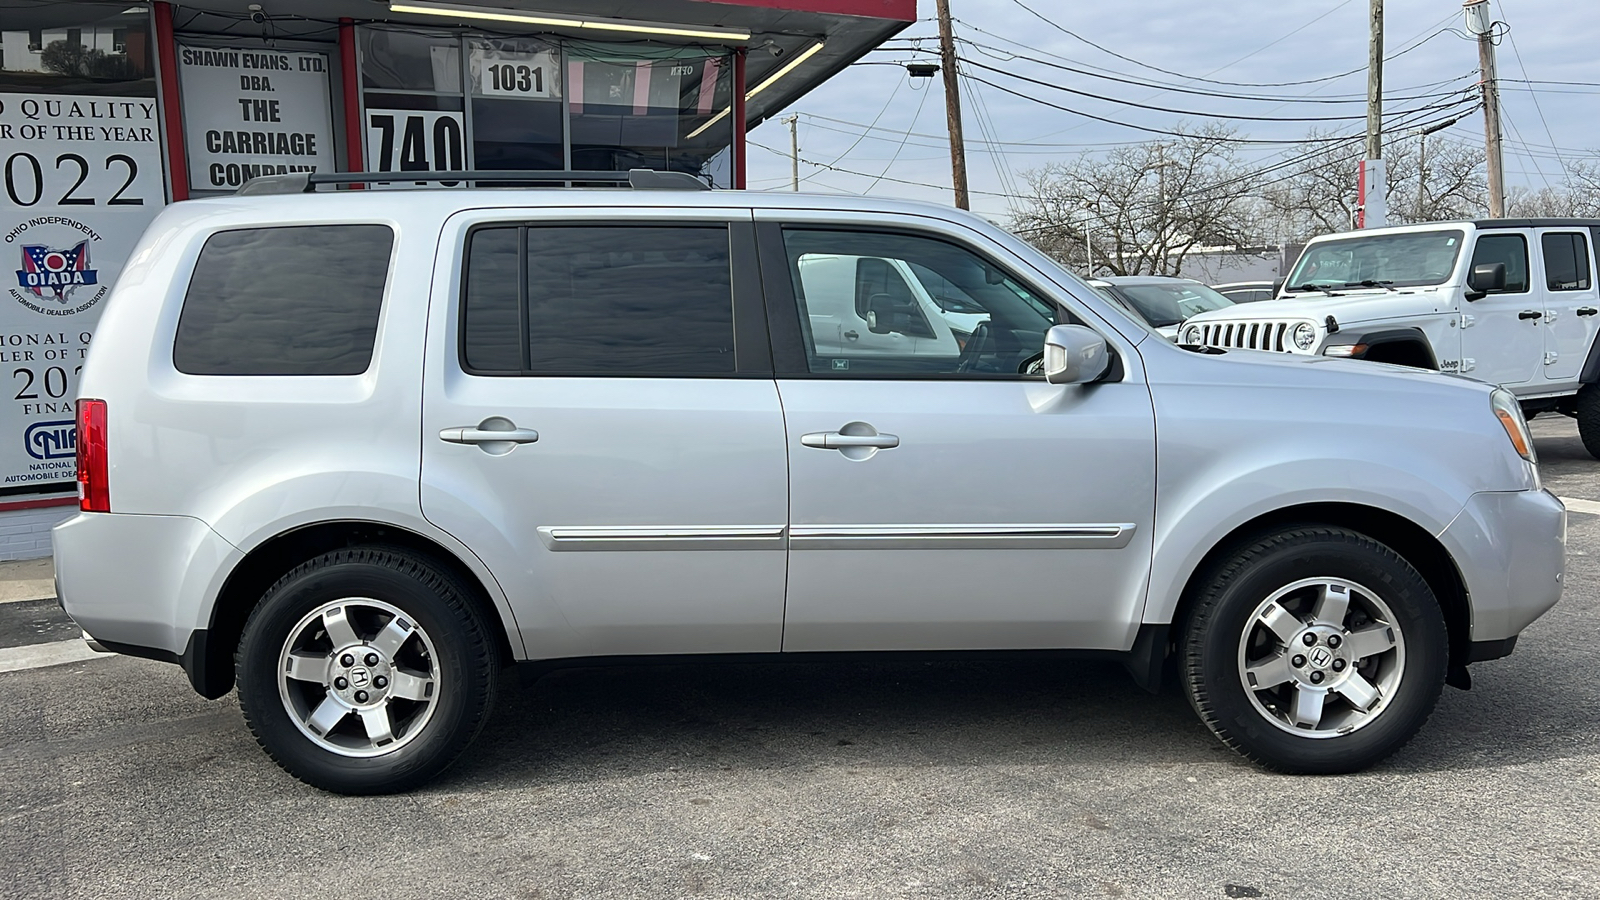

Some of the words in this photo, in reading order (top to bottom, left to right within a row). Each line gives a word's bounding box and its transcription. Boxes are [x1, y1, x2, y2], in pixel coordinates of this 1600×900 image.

[183, 50, 239, 68] SHAWN
[299, 57, 327, 73] LTD.
[240, 75, 275, 91] DBA.
[488, 64, 543, 92] 1031
[21, 99, 154, 120] QUALITY
[239, 99, 281, 122] THE
[20, 125, 47, 140] OF
[53, 125, 95, 141] THE
[100, 127, 154, 142] YEAR
[206, 130, 317, 156] CARRIAGE
[371, 115, 463, 187] 740
[5, 223, 28, 243] OHIO
[28, 216, 102, 242] INDEPENDENT
[27, 271, 85, 286] OIADA
[8, 288, 45, 315] AUTOMOBILE
[46, 308, 75, 316] DEALERS
[76, 285, 108, 313] ASSOCIATION
[44, 349, 68, 360] OF
[1440, 359, 1459, 369] Jeep
[13, 365, 83, 400] 20
[5, 471, 59, 482] AUTOMOBILE
[29, 461, 71, 471] NATIONAL
